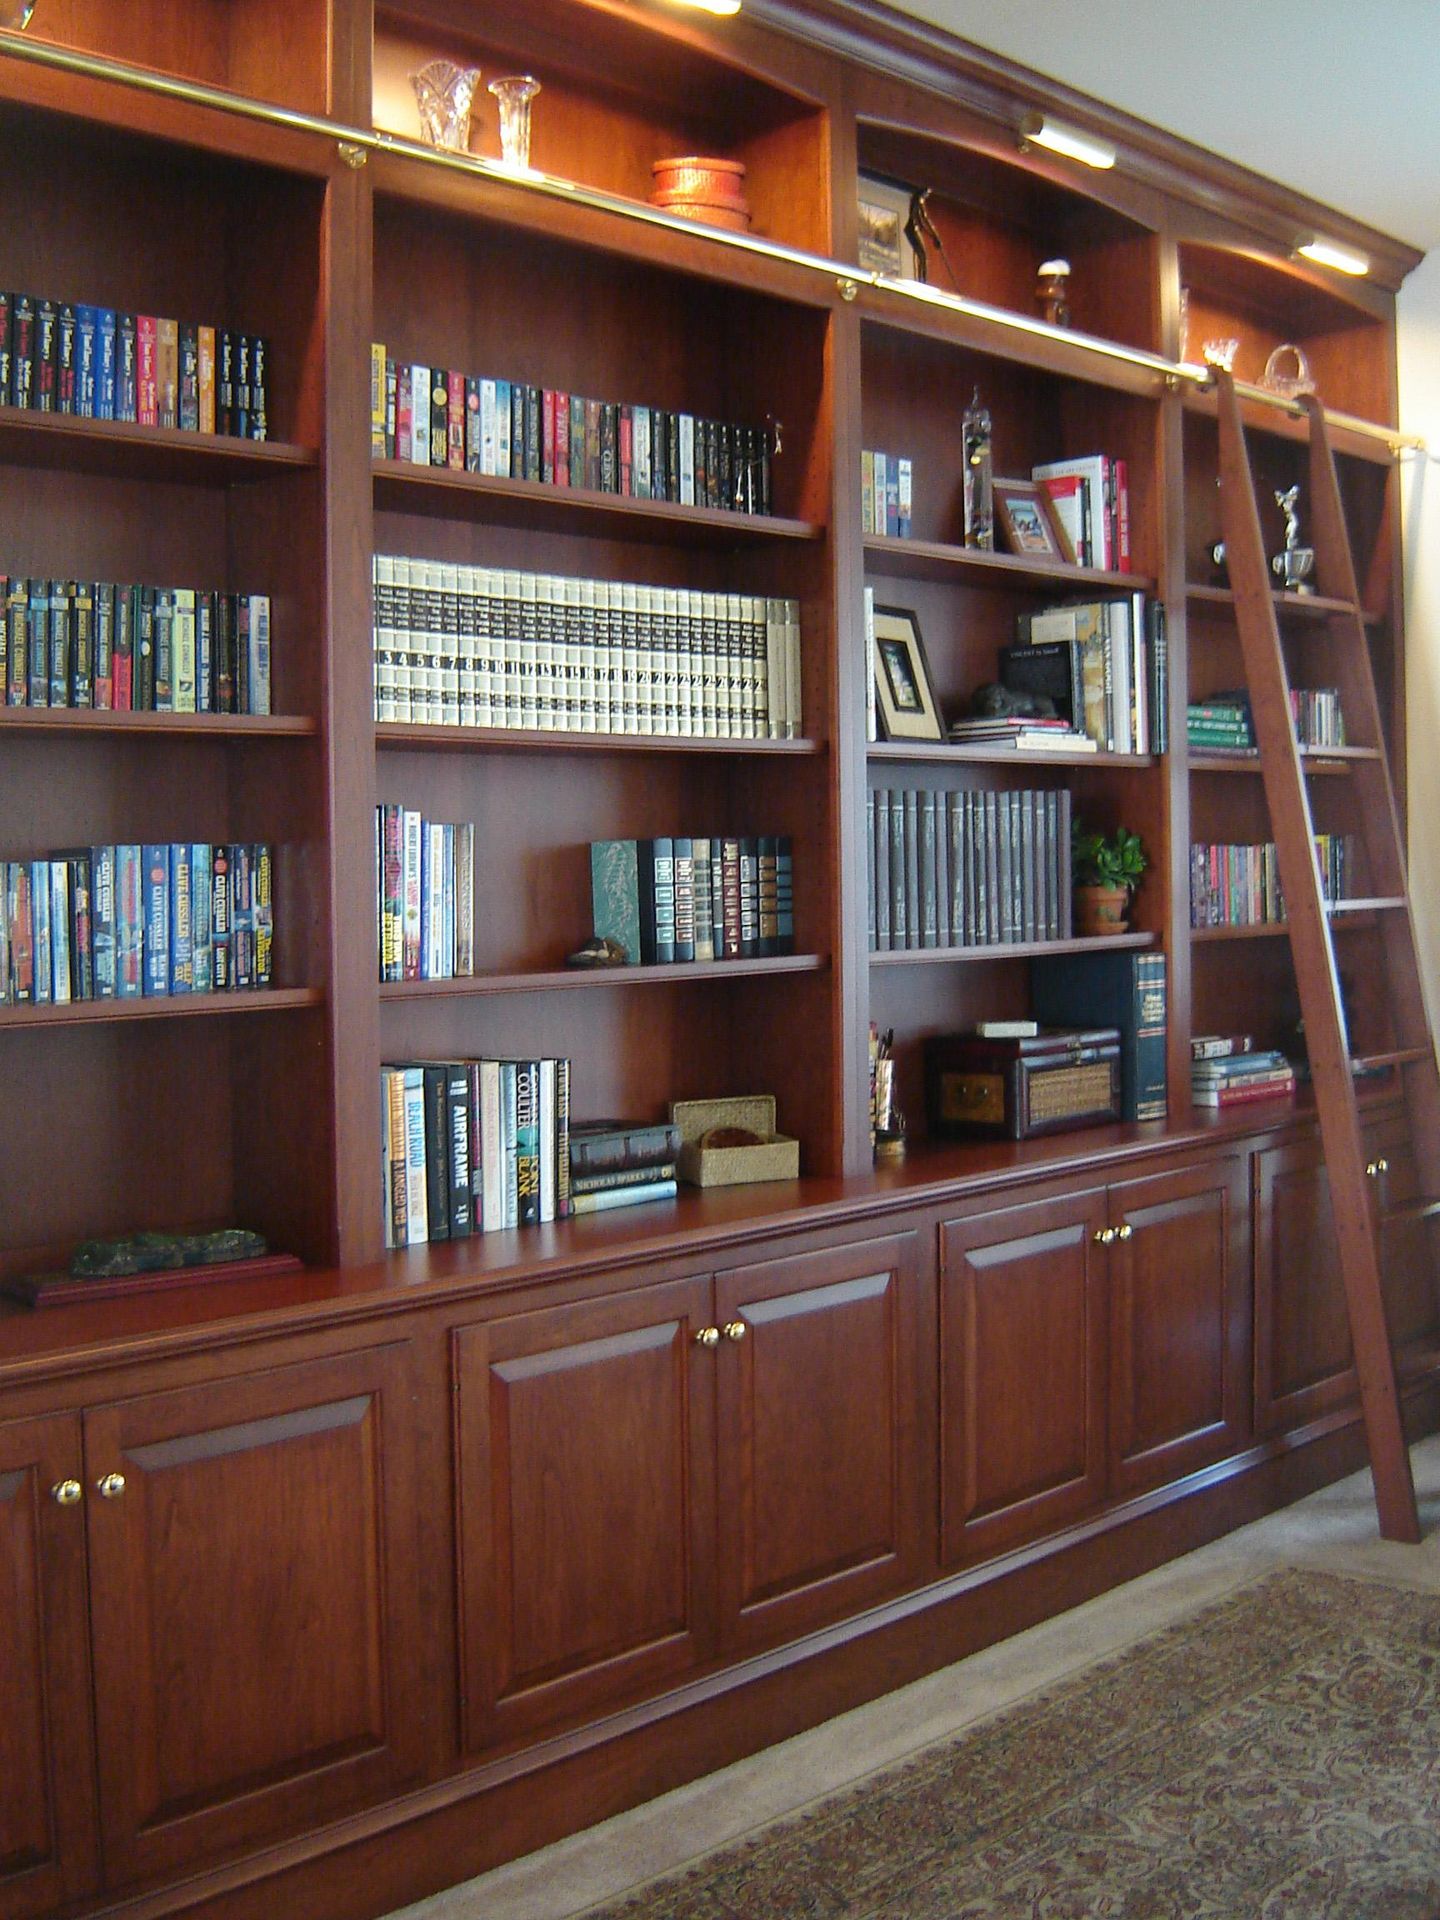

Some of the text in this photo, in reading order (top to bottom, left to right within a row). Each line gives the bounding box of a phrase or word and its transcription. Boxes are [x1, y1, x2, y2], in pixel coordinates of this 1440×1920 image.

[384, 651, 393, 665] 3
[399, 653, 408, 667] 4
[416, 654, 425, 668] 5
[432, 655, 441, 669] 6
[449, 658, 458, 670] 7
[465, 658, 474, 671] 8
[481, 659, 490, 672] 9
[495, 660, 506, 673] 10
[511, 661, 521, 674] 11
[525, 662, 537, 676] 12
[177, 863, 189, 938] CLIVE CUSSLER
[215, 874, 227, 934] CLIVE CUSSLER
[153, 885, 164, 951] CLIVE CUSSLER
[517, 1073, 531, 1130] COULTER
[408, 1102, 425, 1167] BEACH ROAD
[453, 1105, 468, 1189] AIRFRAME
[518, 1156, 532, 1198] BLANK
